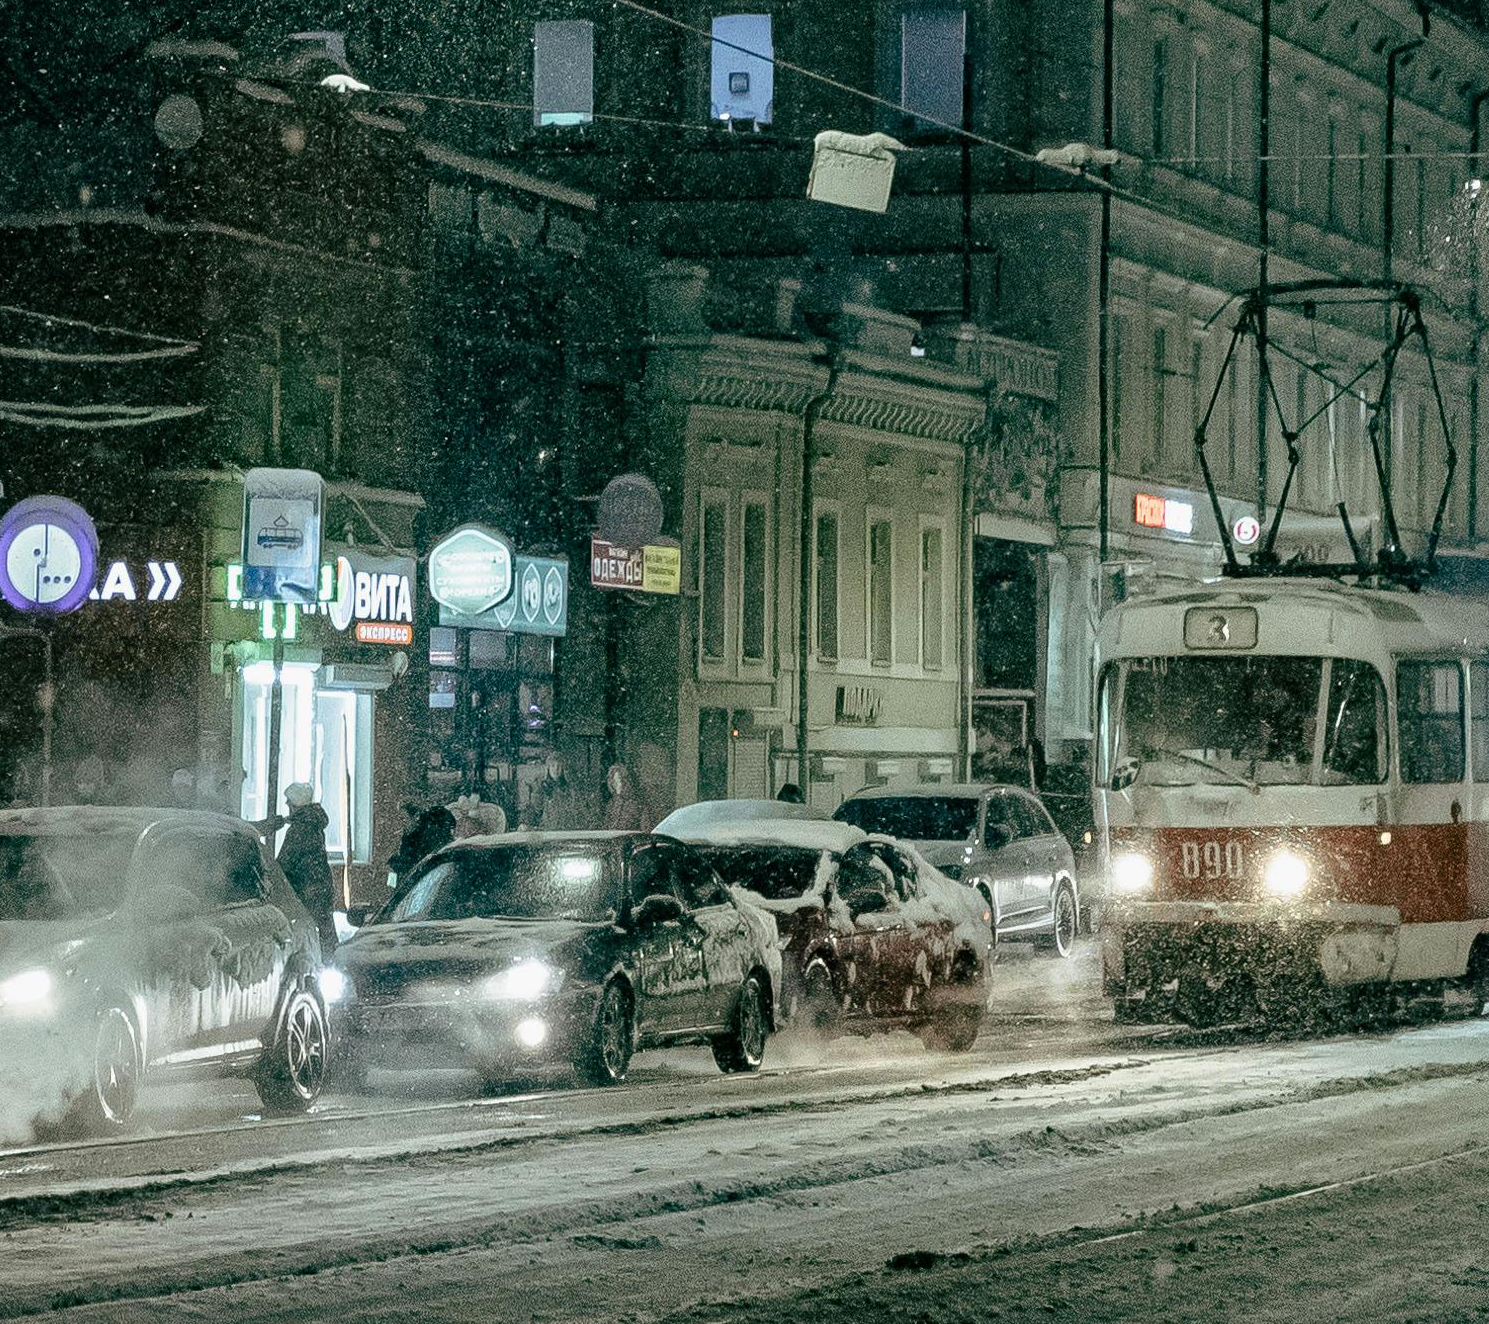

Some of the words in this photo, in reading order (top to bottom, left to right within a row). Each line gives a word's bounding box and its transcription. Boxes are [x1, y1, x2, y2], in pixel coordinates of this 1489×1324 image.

[354, 571, 413, 623] ВИТА
[359, 627, 409, 642] ЭКСПРЕСС
[1181, 841, 1244, 879] 890
